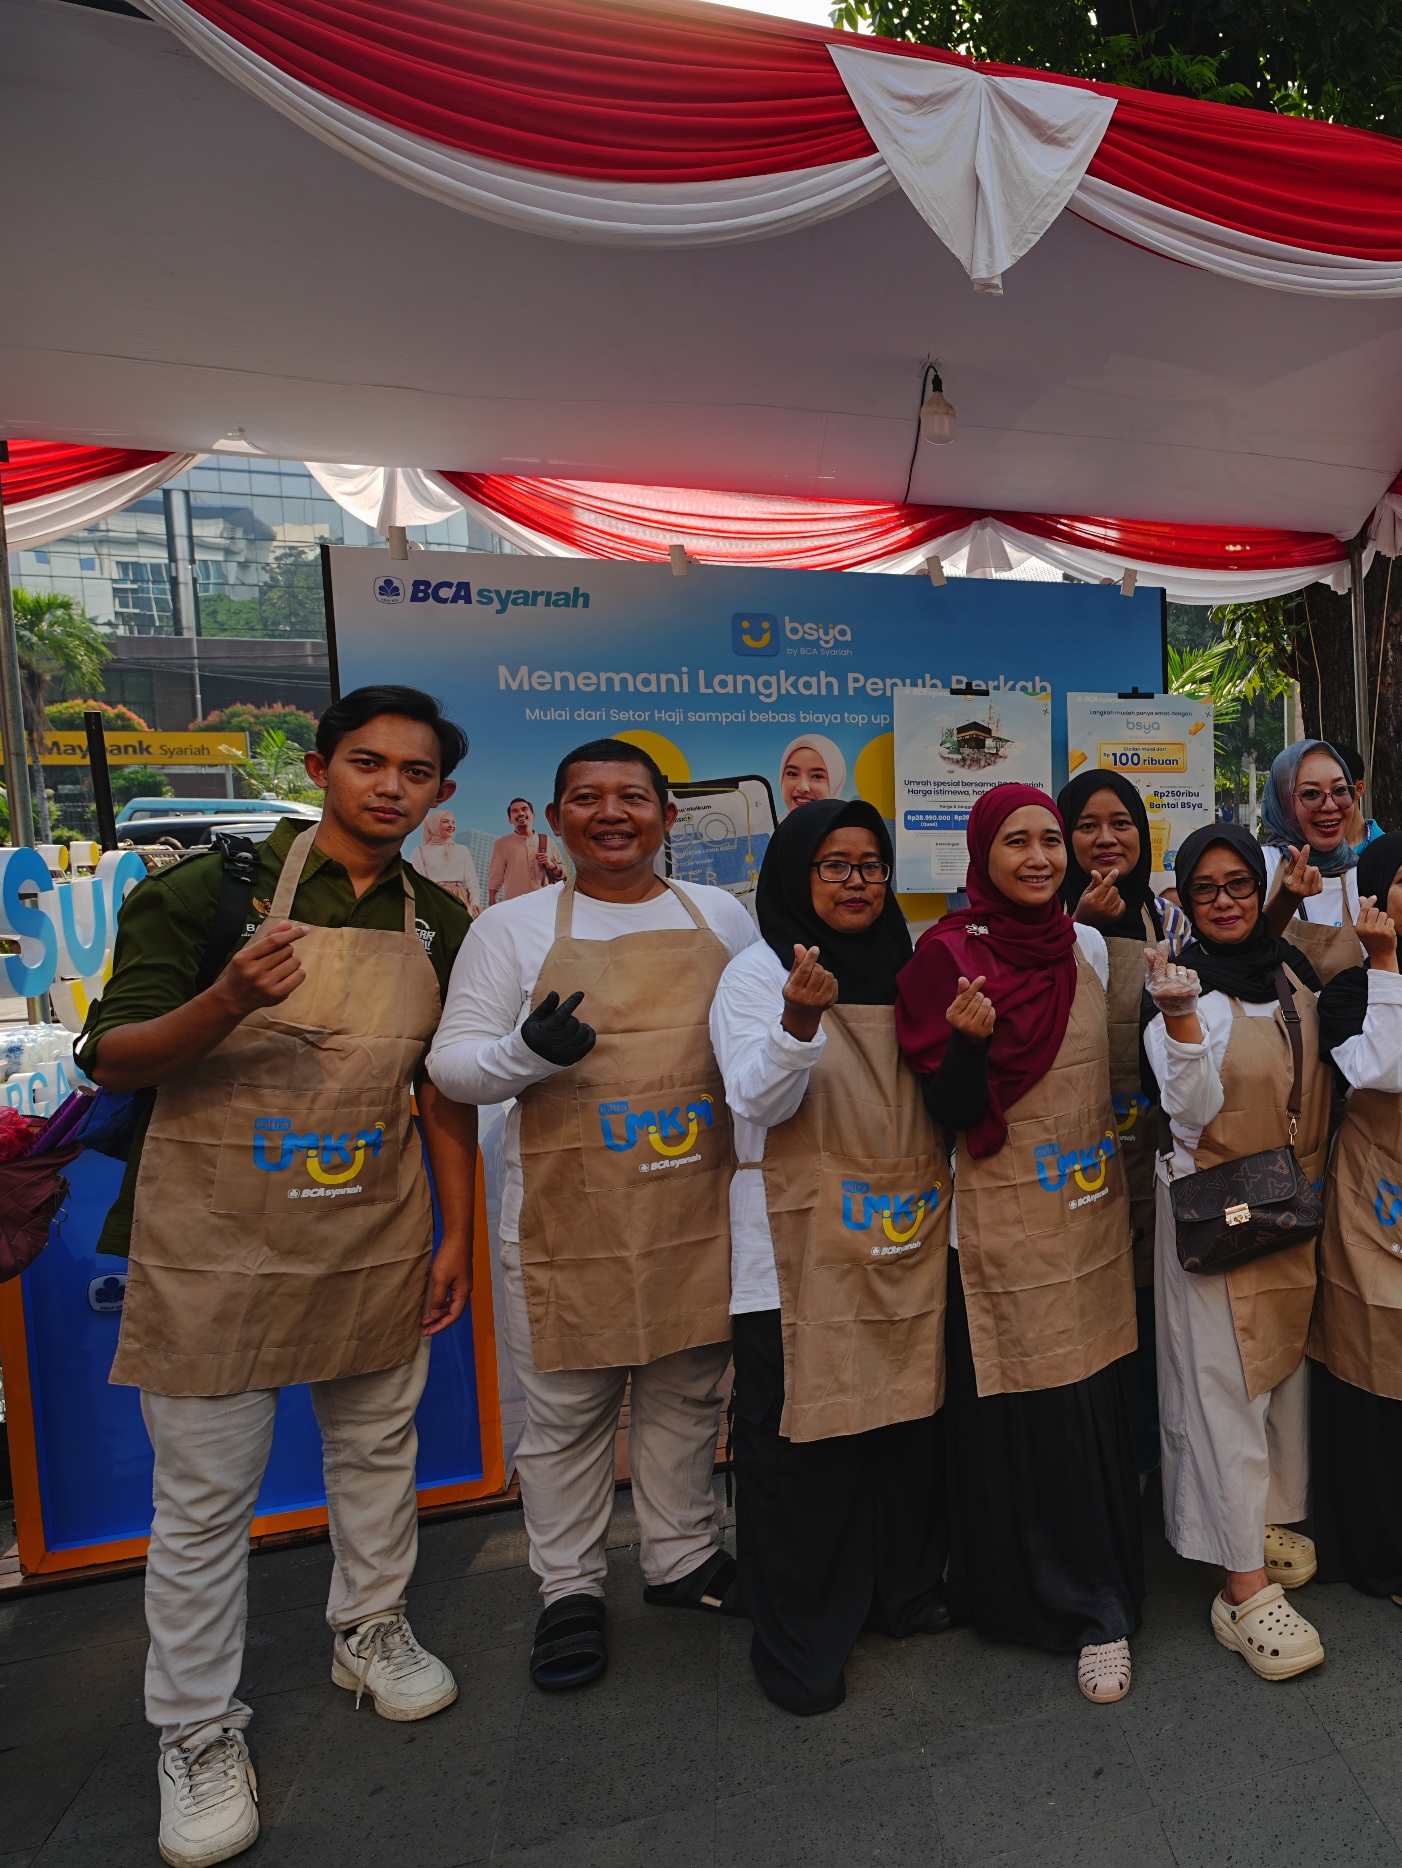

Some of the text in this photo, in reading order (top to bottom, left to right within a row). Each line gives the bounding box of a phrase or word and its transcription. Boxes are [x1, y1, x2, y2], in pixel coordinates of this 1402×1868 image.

[785, 616, 852, 648] bsya
[787, 647, 798, 656] by
[820, 648, 853, 657] Syariah
[498, 665, 689, 693] Menemani
[699, 669, 839, 703] Langkah
[525, 708, 890, 727] Mulai dari Setor Haji sampai bebas biaya top up
[1126, 719, 1160, 734] bsya
[43, 740, 210, 759] Mayank Syariah
[1111, 753, 1141, 766] 100
[907, 788, 932, 796] Harga
[933, 780, 960, 788] spesial
[1154, 790, 1199, 799] Rp250ribu
[1180, 802, 1203, 810] BSya
[257, 1120, 289, 1129] mitra
[600, 1100, 713, 1152] UMKM
[253, 1127, 383, 1172] UMKM
[1036, 1137, 1115, 1192] UMKM
[842, 1187, 939, 1231] UMKM
